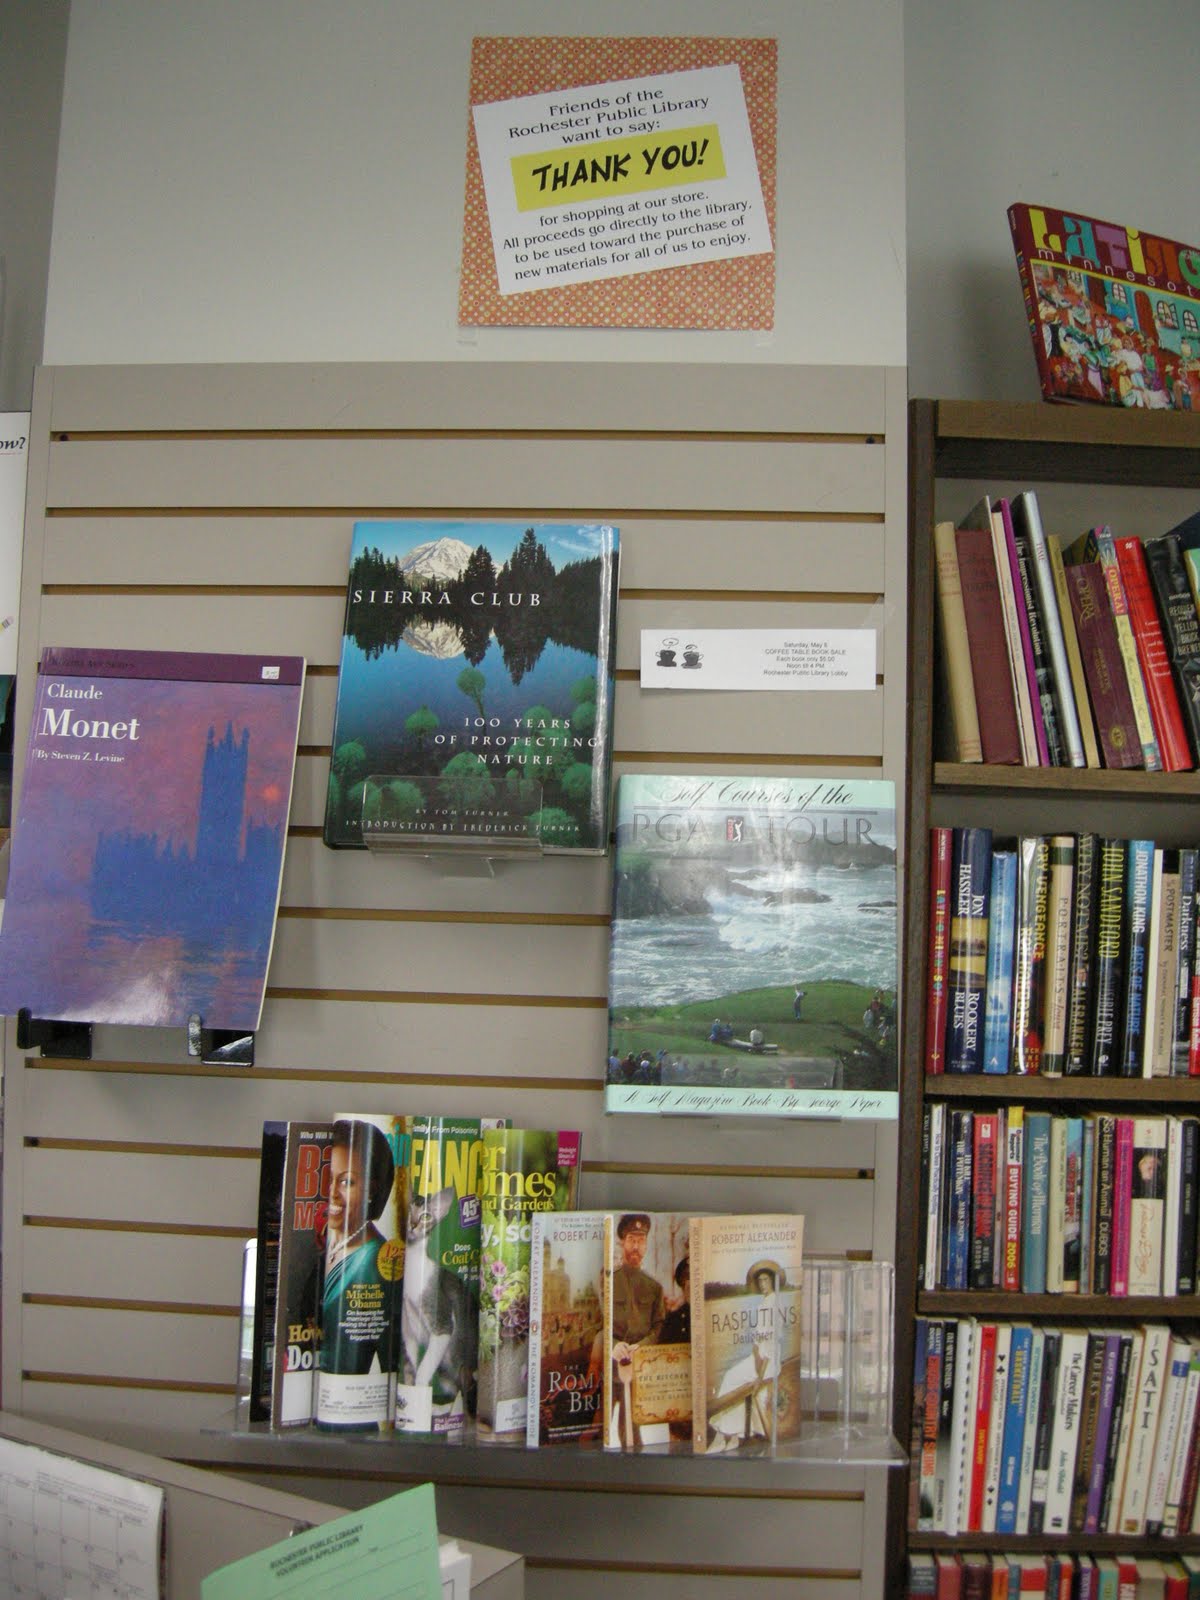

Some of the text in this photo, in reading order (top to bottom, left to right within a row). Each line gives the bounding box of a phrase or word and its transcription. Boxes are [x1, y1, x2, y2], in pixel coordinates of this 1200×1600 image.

[509, 97, 709, 138] Rochester Public Library
[549, 88, 663, 116] Friends of the
[562, 120, 660, 144] want to say:
[532, 139, 709, 192] THANK YOU!
[540, 191, 709, 227] for shopping at our store.
[503, 238, 519, 250] All
[524, 225, 585, 248] proceeds
[589, 223, 605, 237] go
[610, 214, 658, 231] directly
[662, 212, 676, 223] to
[680, 208, 702, 221] the
[515, 215, 745, 263] to be used toward the purchase of
[515, 234, 751, 280] new materials for all of us to enjoy.
[353, 590, 542, 606] SIERRA CLUB
[1015, 540, 1042, 655] The Impressionist Revolution
[1076, 577, 1096, 630] OPERA
[1108, 569, 1125, 615] OPERA!
[47, 683, 103, 700] Claude
[39, 707, 140, 740] Monet
[434, 734, 599, 748] OF PROTECTING
[464, 717, 571, 729] 100 YEARS
[37, 750, 50, 760] By
[51, 751, 80, 761] Steven
[95, 753, 125, 763] Levine
[477, 754, 554, 765] NATURE
[718, 780, 855, 812] Courses of the
[758, 815, 880, 848] TOUR
[1078, 835, 1093, 880] WHY
[958, 863, 971, 916] HASSLER
[971, 895, 985, 916] JON
[1033, 844, 1049, 959] CRY VENGEANCE
[1098, 847, 1124, 958] JOHN SANDFORD
[1132, 849, 1148, 933] JONATHON KING
[1164, 888, 1176, 952] POSTMASTER
[1180, 895, 1192, 950] Darkness
[1131, 945, 1143, 972] ACTS
[1131, 975, 1142, 989] OF
[953, 991, 965, 1029] BLUES
[966, 992, 980, 1051] ROOKERY
[1096, 1020, 1113, 1045] PREY
[451, 1127, 478, 1135] Poisoning
[1031, 1134, 1047, 1235] The Book of Mormon
[1098, 1119, 1112, 1256] So Human an Animal DUBOS
[501, 1198, 555, 1211] Gardens
[1007, 1168, 1019, 1268] BUYING GUIDE 2006
[554, 1231, 588, 1241] ROBERT
[712, 1231, 797, 1245] ROBERT ALEXANDER
[442, 1251, 468, 1265] Coat
[346, 1290, 384, 1299] Michelle
[350, 1300, 381, 1308] Obama
[1011, 1351, 1022, 1404] BASKETBALL
[1091, 1340, 1105, 1396] EMBERS
[1065, 1353, 1082, 1430] The Career Makers
[309, 1536, 334, 1550] PUBLIC
[335, 1524, 363, 1541] LIBRARY
